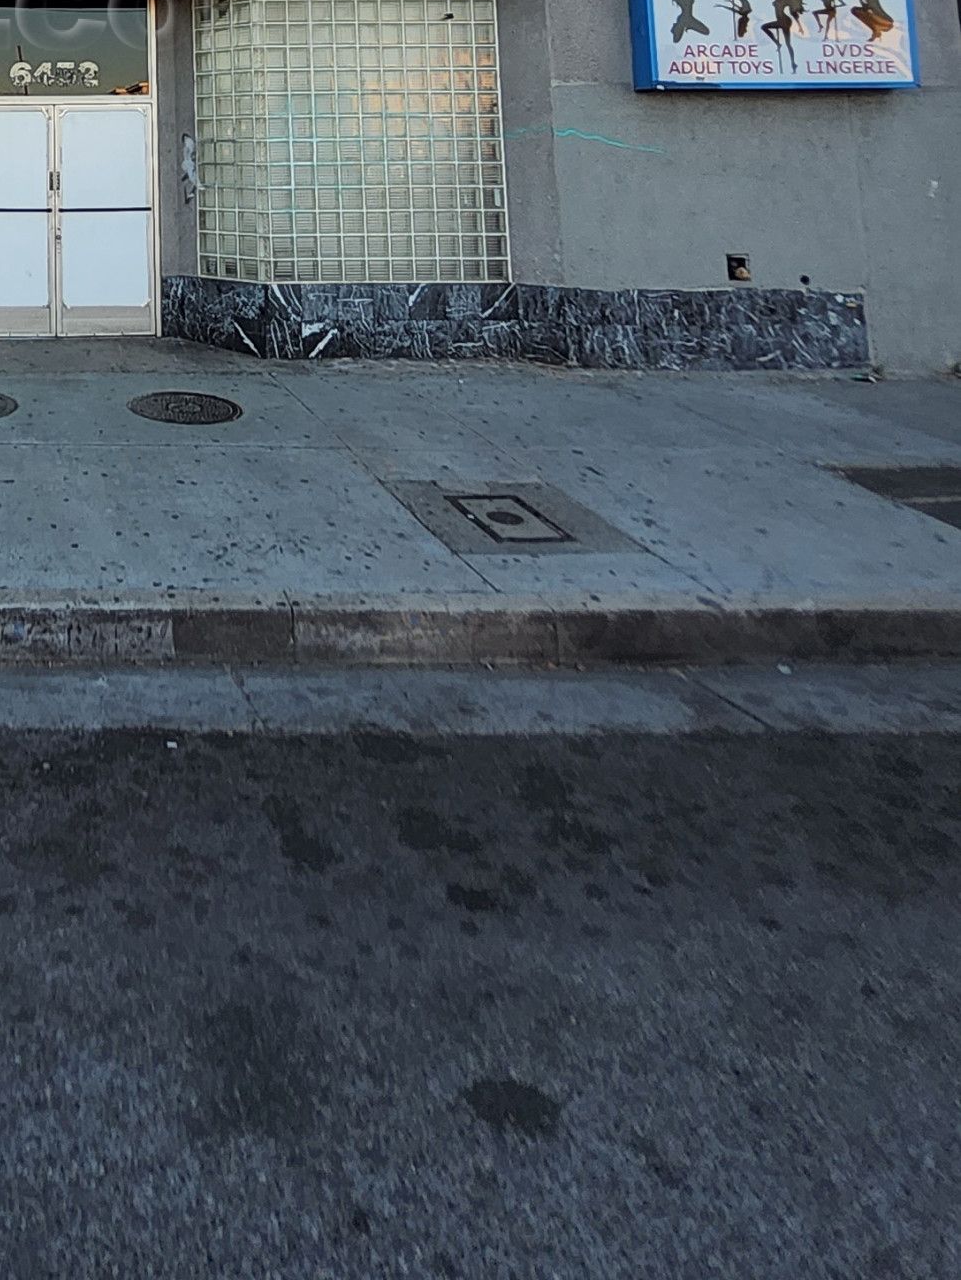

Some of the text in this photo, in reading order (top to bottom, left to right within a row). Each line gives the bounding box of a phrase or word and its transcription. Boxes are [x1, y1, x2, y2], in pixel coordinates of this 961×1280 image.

[683, 44, 759, 58] ARCADE
[822, 44, 874, 58] DVDS
[668, 60, 774, 75] ADULT TOYS
[806, 60, 897, 75] LINGERIE
